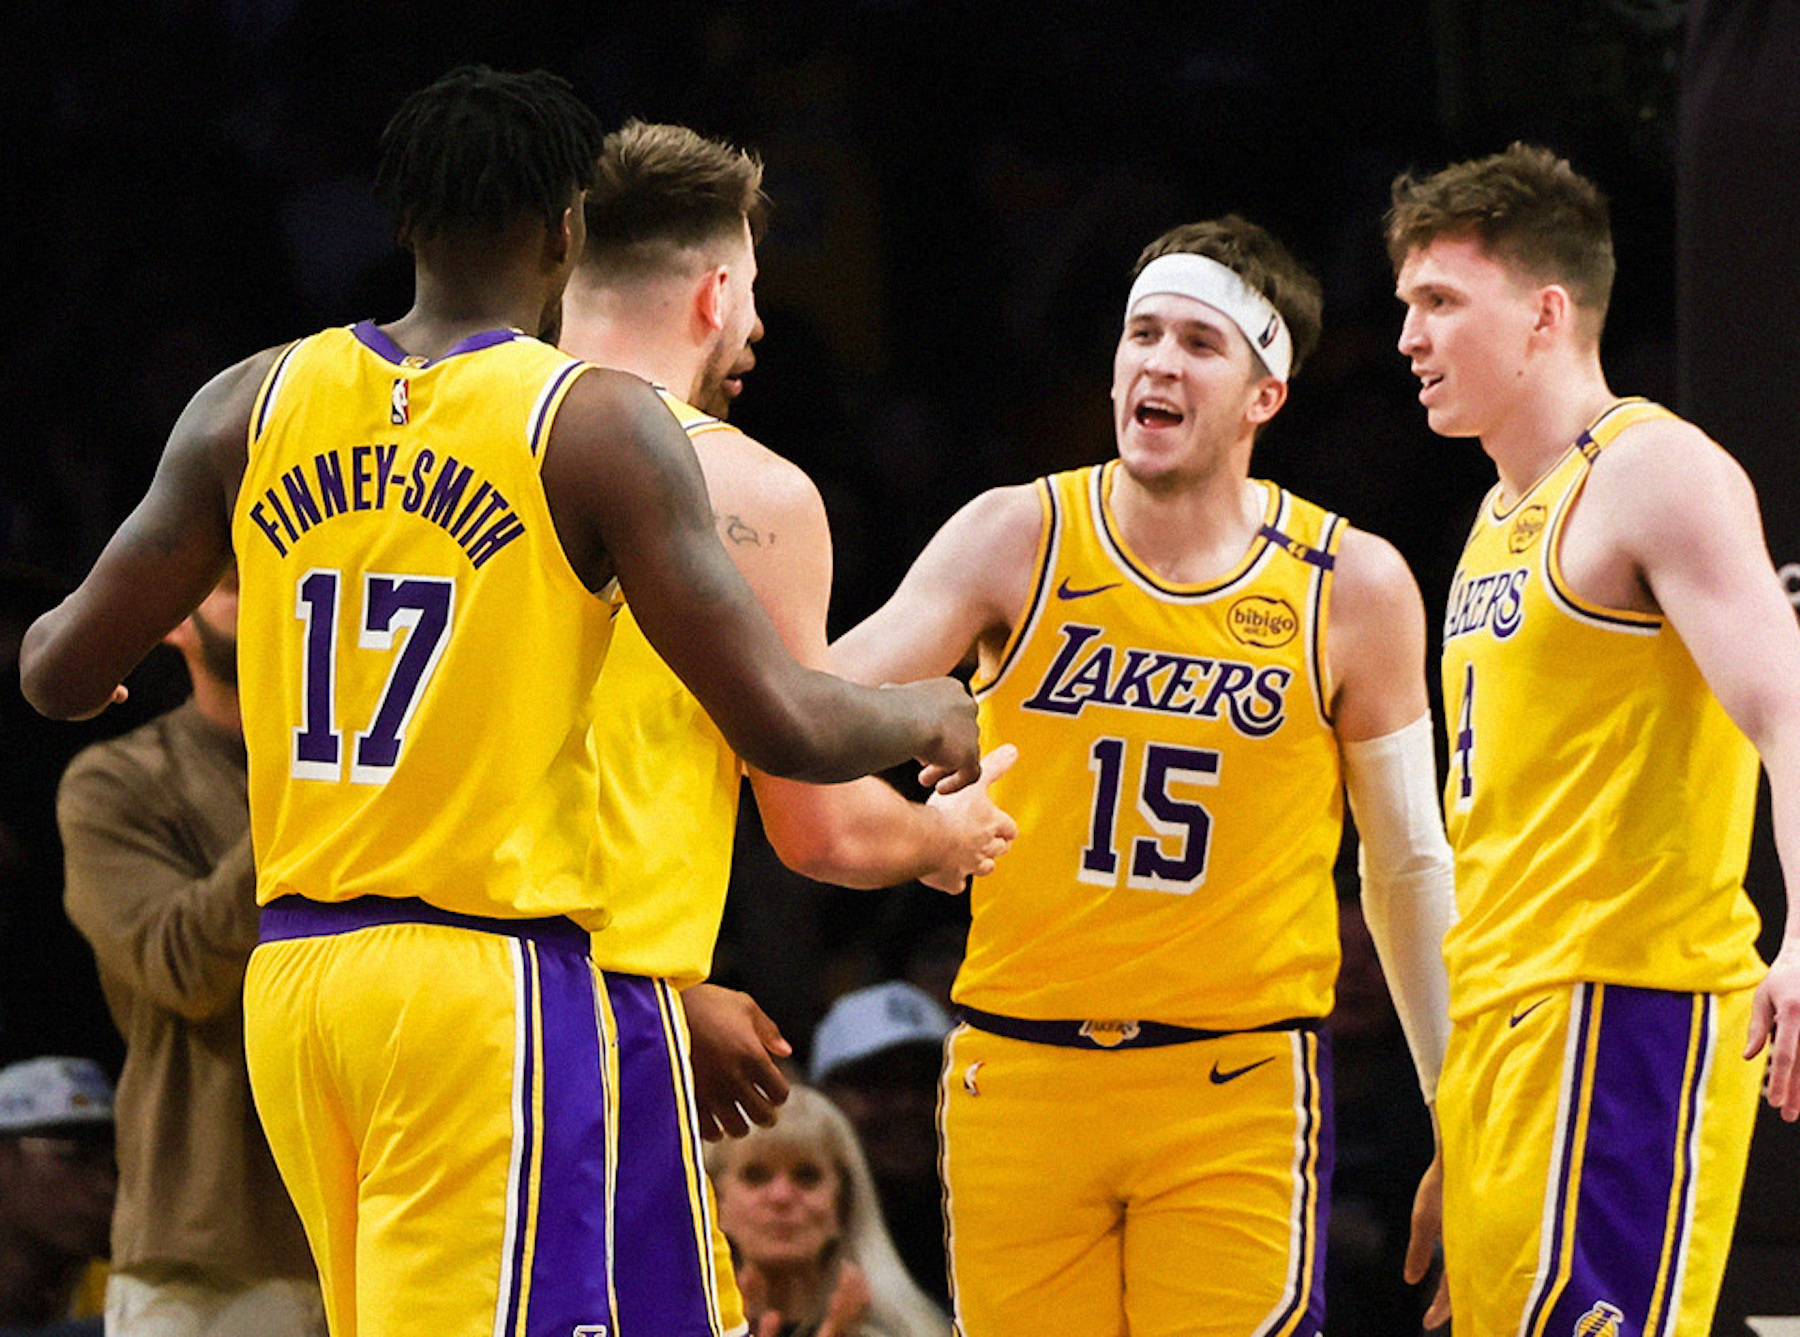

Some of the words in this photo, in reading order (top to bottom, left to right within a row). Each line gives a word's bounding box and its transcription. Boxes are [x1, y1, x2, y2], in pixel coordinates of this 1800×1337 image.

[249, 444, 527, 570] FINNEY-SMITH
[1234, 607, 1293, 635] bibigo
[1443, 568, 1528, 640] AKERS
[291, 567, 456, 786] 17
[1020, 622, 1293, 738] LAKERS
[1076, 735, 1223, 895] 15
